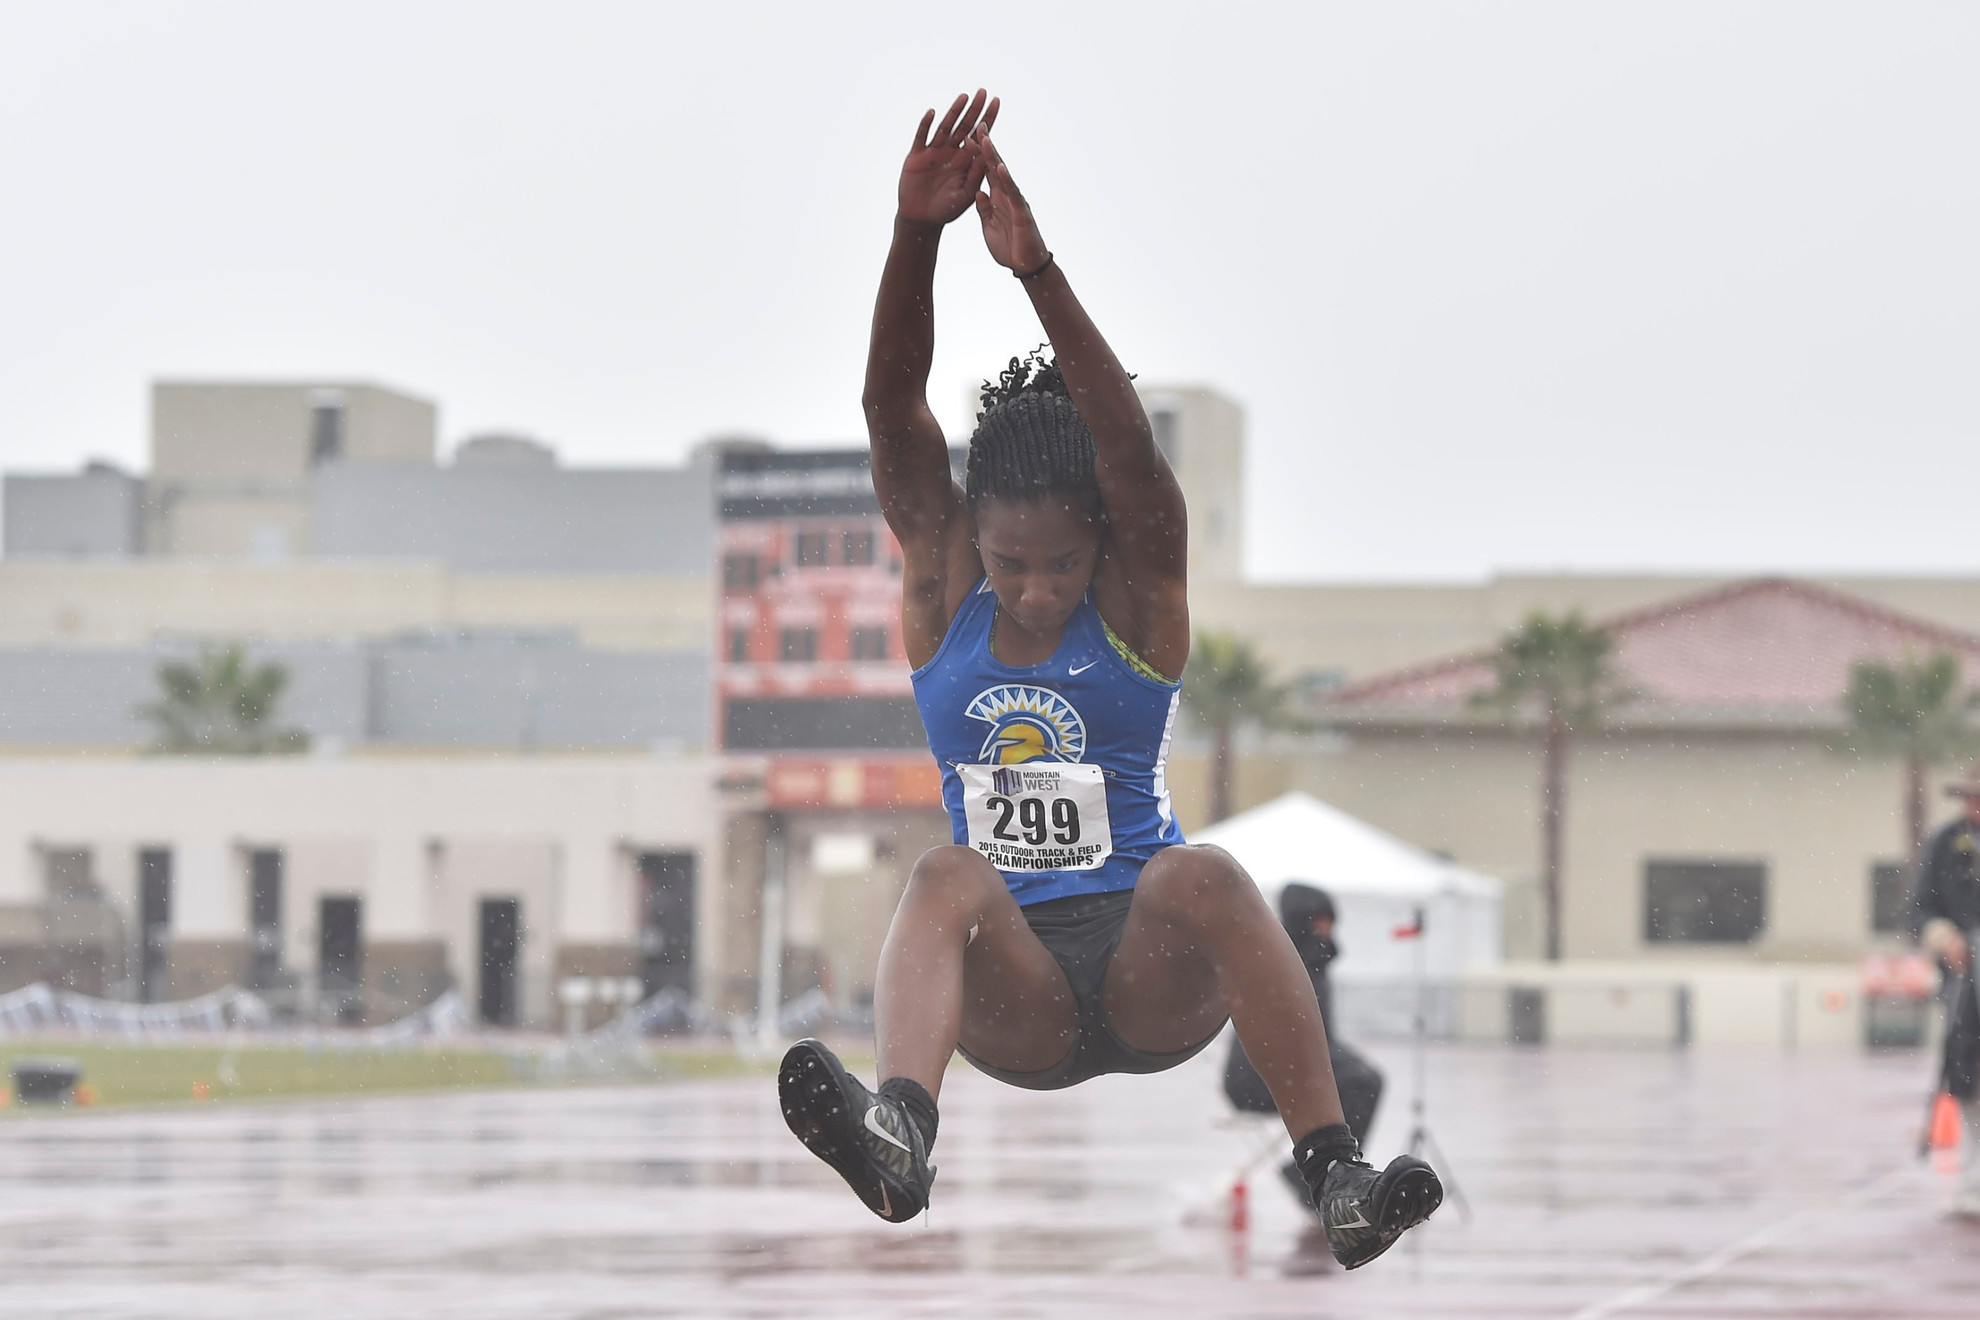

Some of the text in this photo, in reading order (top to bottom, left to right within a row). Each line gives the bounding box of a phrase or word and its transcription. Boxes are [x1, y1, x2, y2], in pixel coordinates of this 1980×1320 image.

[1023, 771, 1060, 779] MOUNTAIN
[1024, 779, 1061, 791] WEST
[986, 797, 1080, 845] 299
[978, 841, 1102, 858] 2015 OUTDOOR TRACK & FIELD
[987, 852, 1094, 870] CHAMPIONSHIPS
